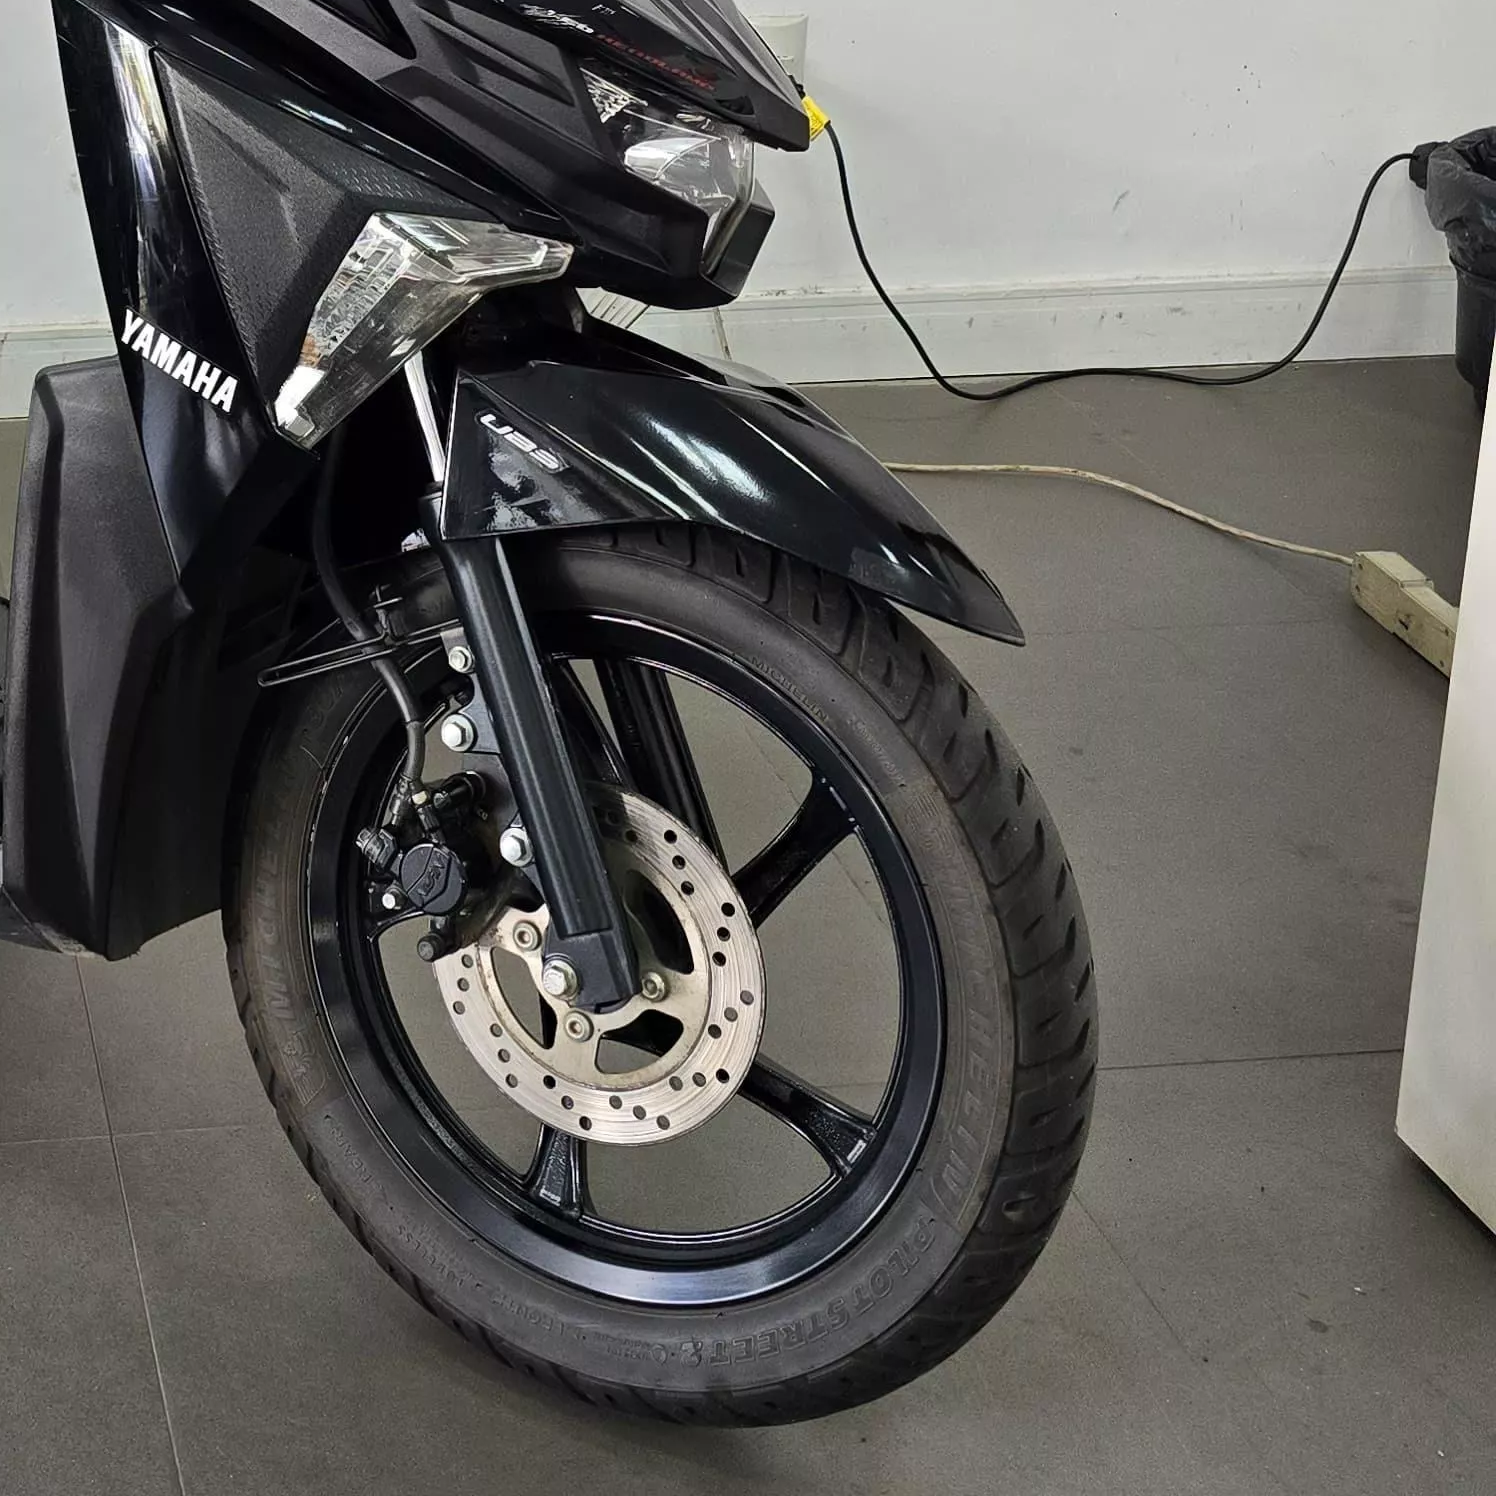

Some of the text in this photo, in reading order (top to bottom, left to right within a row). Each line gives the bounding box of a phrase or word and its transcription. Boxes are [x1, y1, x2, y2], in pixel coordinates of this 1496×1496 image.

[120, 308, 239, 413] YAMAHA
[750, 655, 828, 722] MICHELIN
[854, 1216, 937, 1317] PILOT
[708, 1297, 852, 1366] STREET
